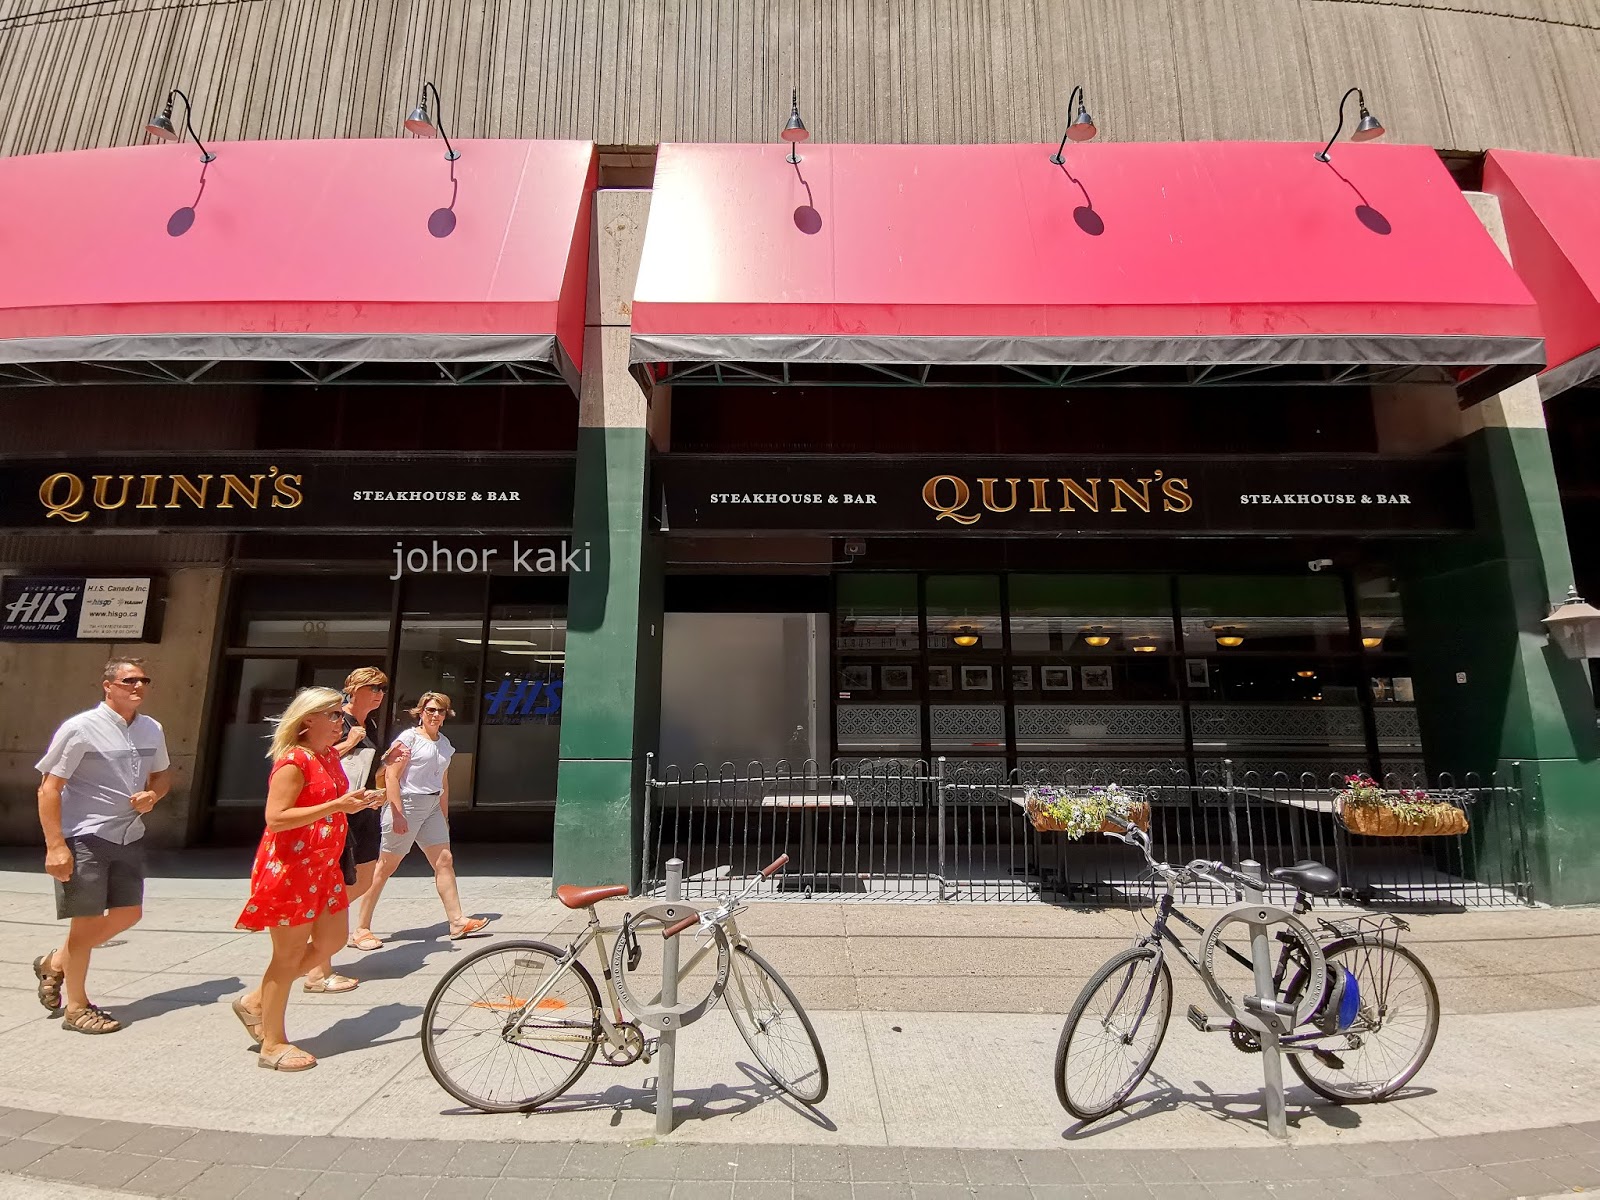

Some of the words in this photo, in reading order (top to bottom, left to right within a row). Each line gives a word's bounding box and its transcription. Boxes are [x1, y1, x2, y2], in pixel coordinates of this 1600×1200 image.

[38, 466, 303, 523] QUINN'S
[352, 490, 467, 502] STEAKHOUSE
[471, 490, 483, 502] &
[486, 490, 521, 502] BAR
[710, 493, 823, 505] STEAKHOUSE
[827, 493, 839, 505] &
[843, 493, 878, 505] BAR
[921, 468, 1193, 525] QUINN'S
[1240, 494, 1356, 506] STEAKHOUSE
[1360, 494, 1373, 506] &
[1376, 494, 1412, 506] BAR
[92, 598, 113, 607] hisgo
[89, 610, 138, 619] www.hisgo.ca
[37, 623, 61, 631] TRAVEL
